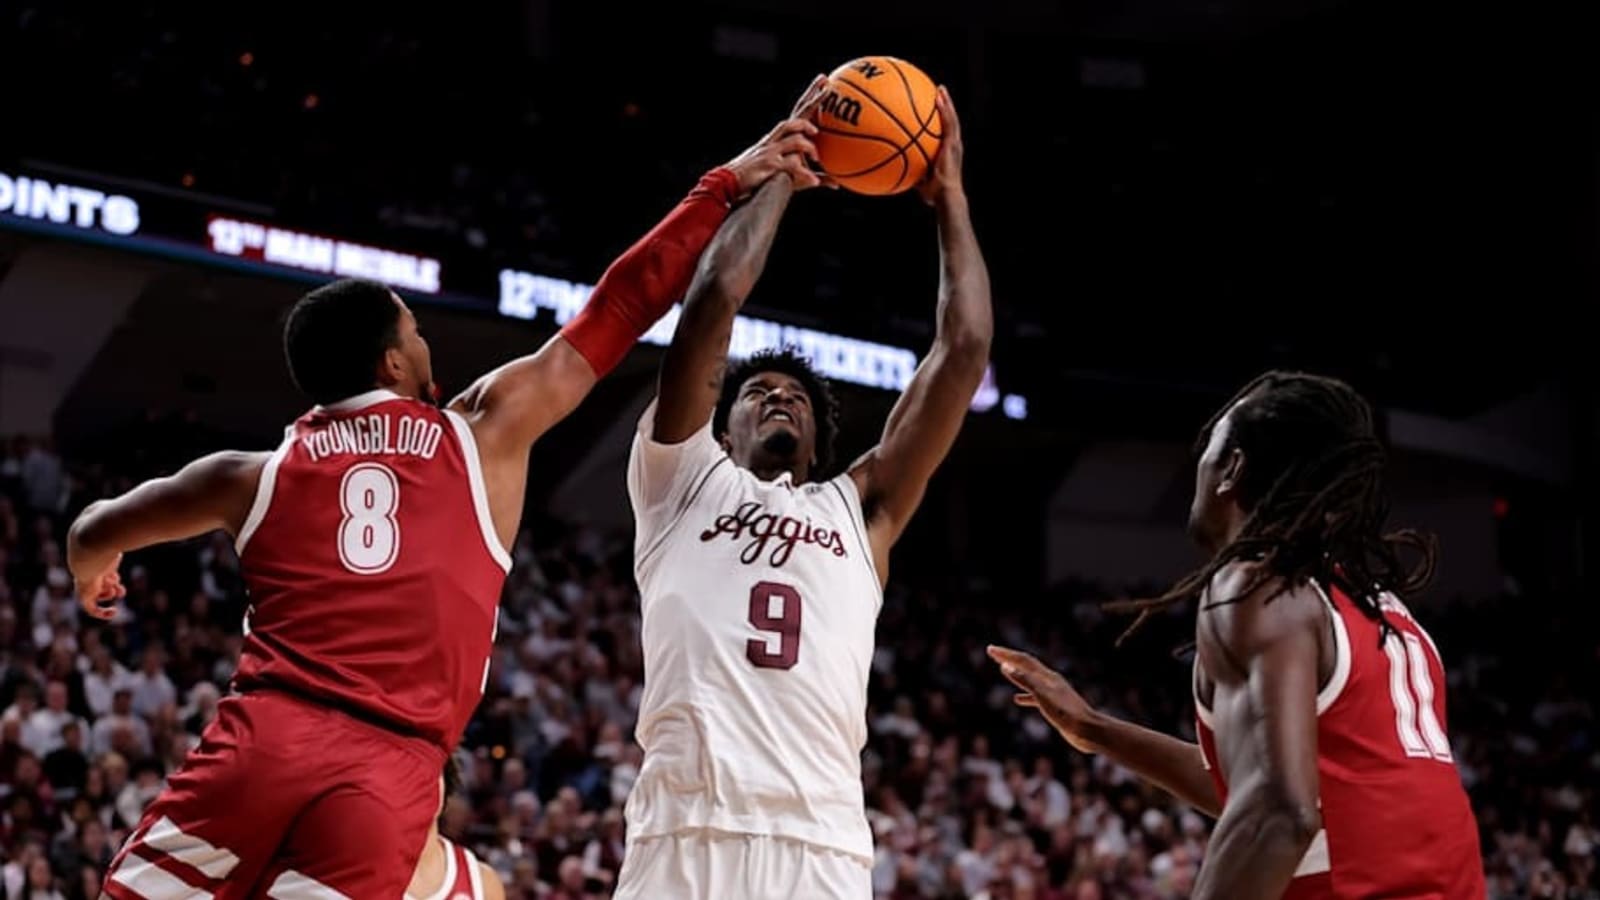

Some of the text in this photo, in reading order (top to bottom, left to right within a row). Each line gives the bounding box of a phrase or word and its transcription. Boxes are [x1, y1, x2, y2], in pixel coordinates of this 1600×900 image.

[303, 414, 443, 462] YOUNGBLOOD
[337, 461, 400, 575] 8
[700, 502, 847, 568] Aggies
[746, 581, 802, 670] 9
[1381, 628, 1454, 764] 11
